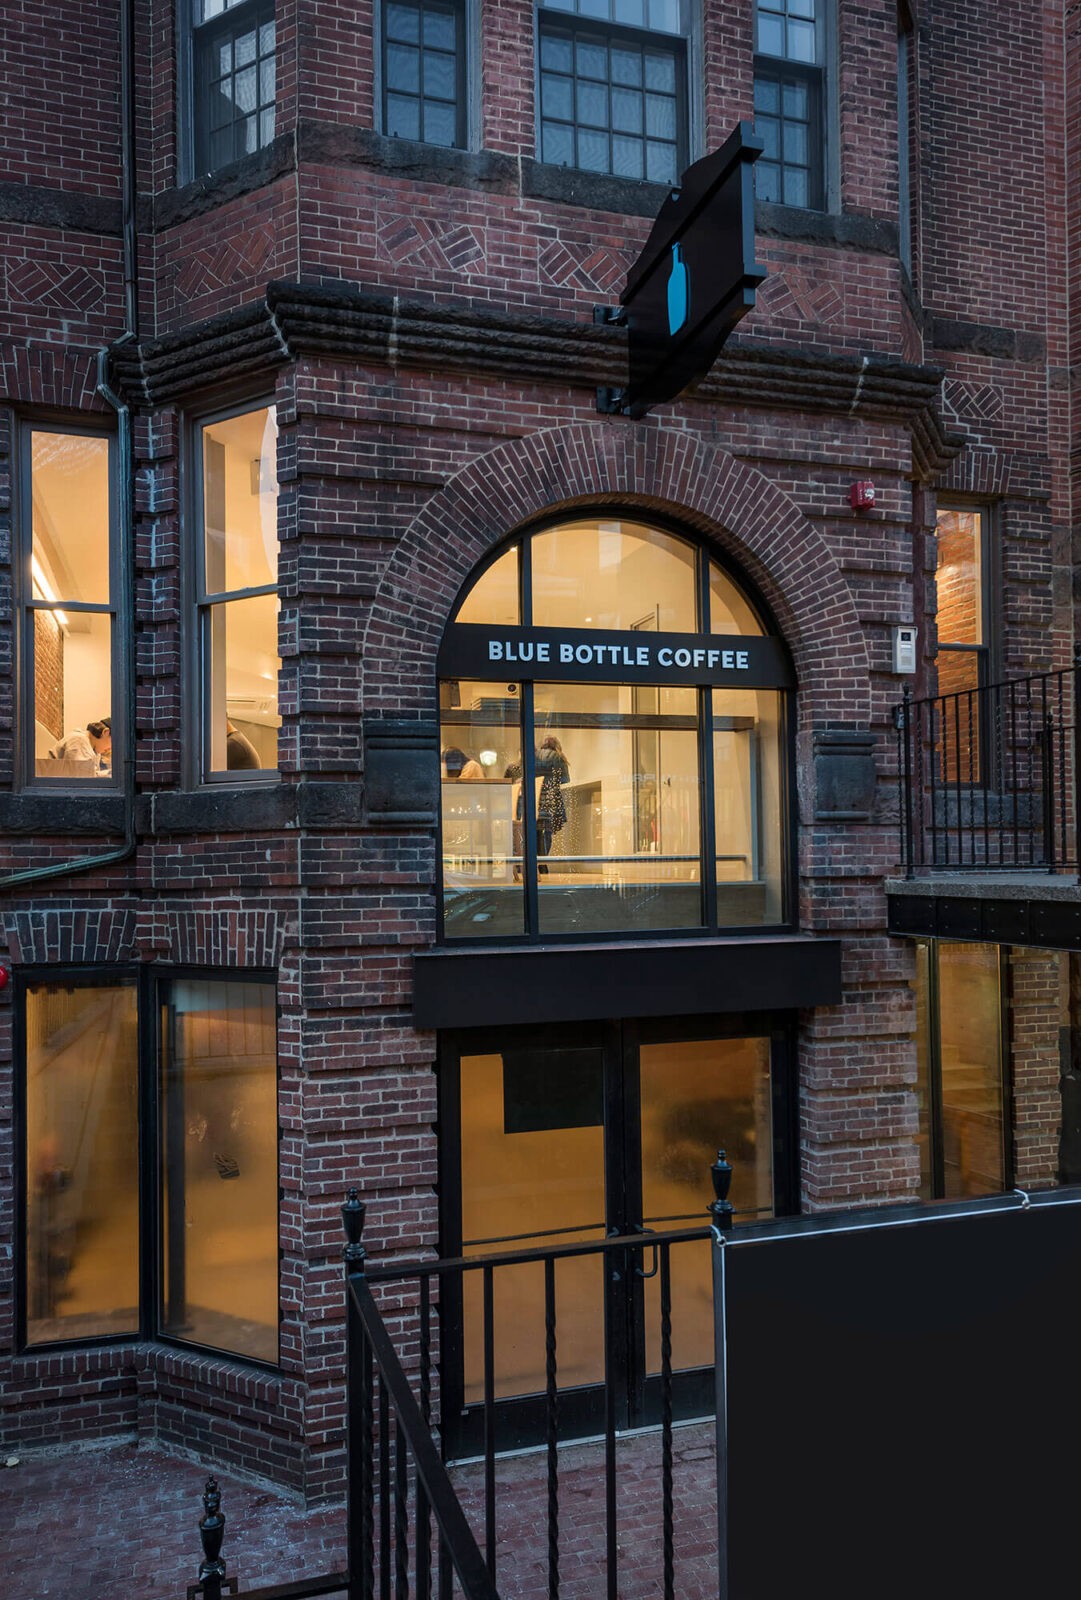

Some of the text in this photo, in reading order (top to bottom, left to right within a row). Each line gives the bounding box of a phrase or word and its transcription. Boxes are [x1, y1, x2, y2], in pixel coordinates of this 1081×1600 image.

[488, 640, 750, 670] BLUE BOTTLE COFFEE
